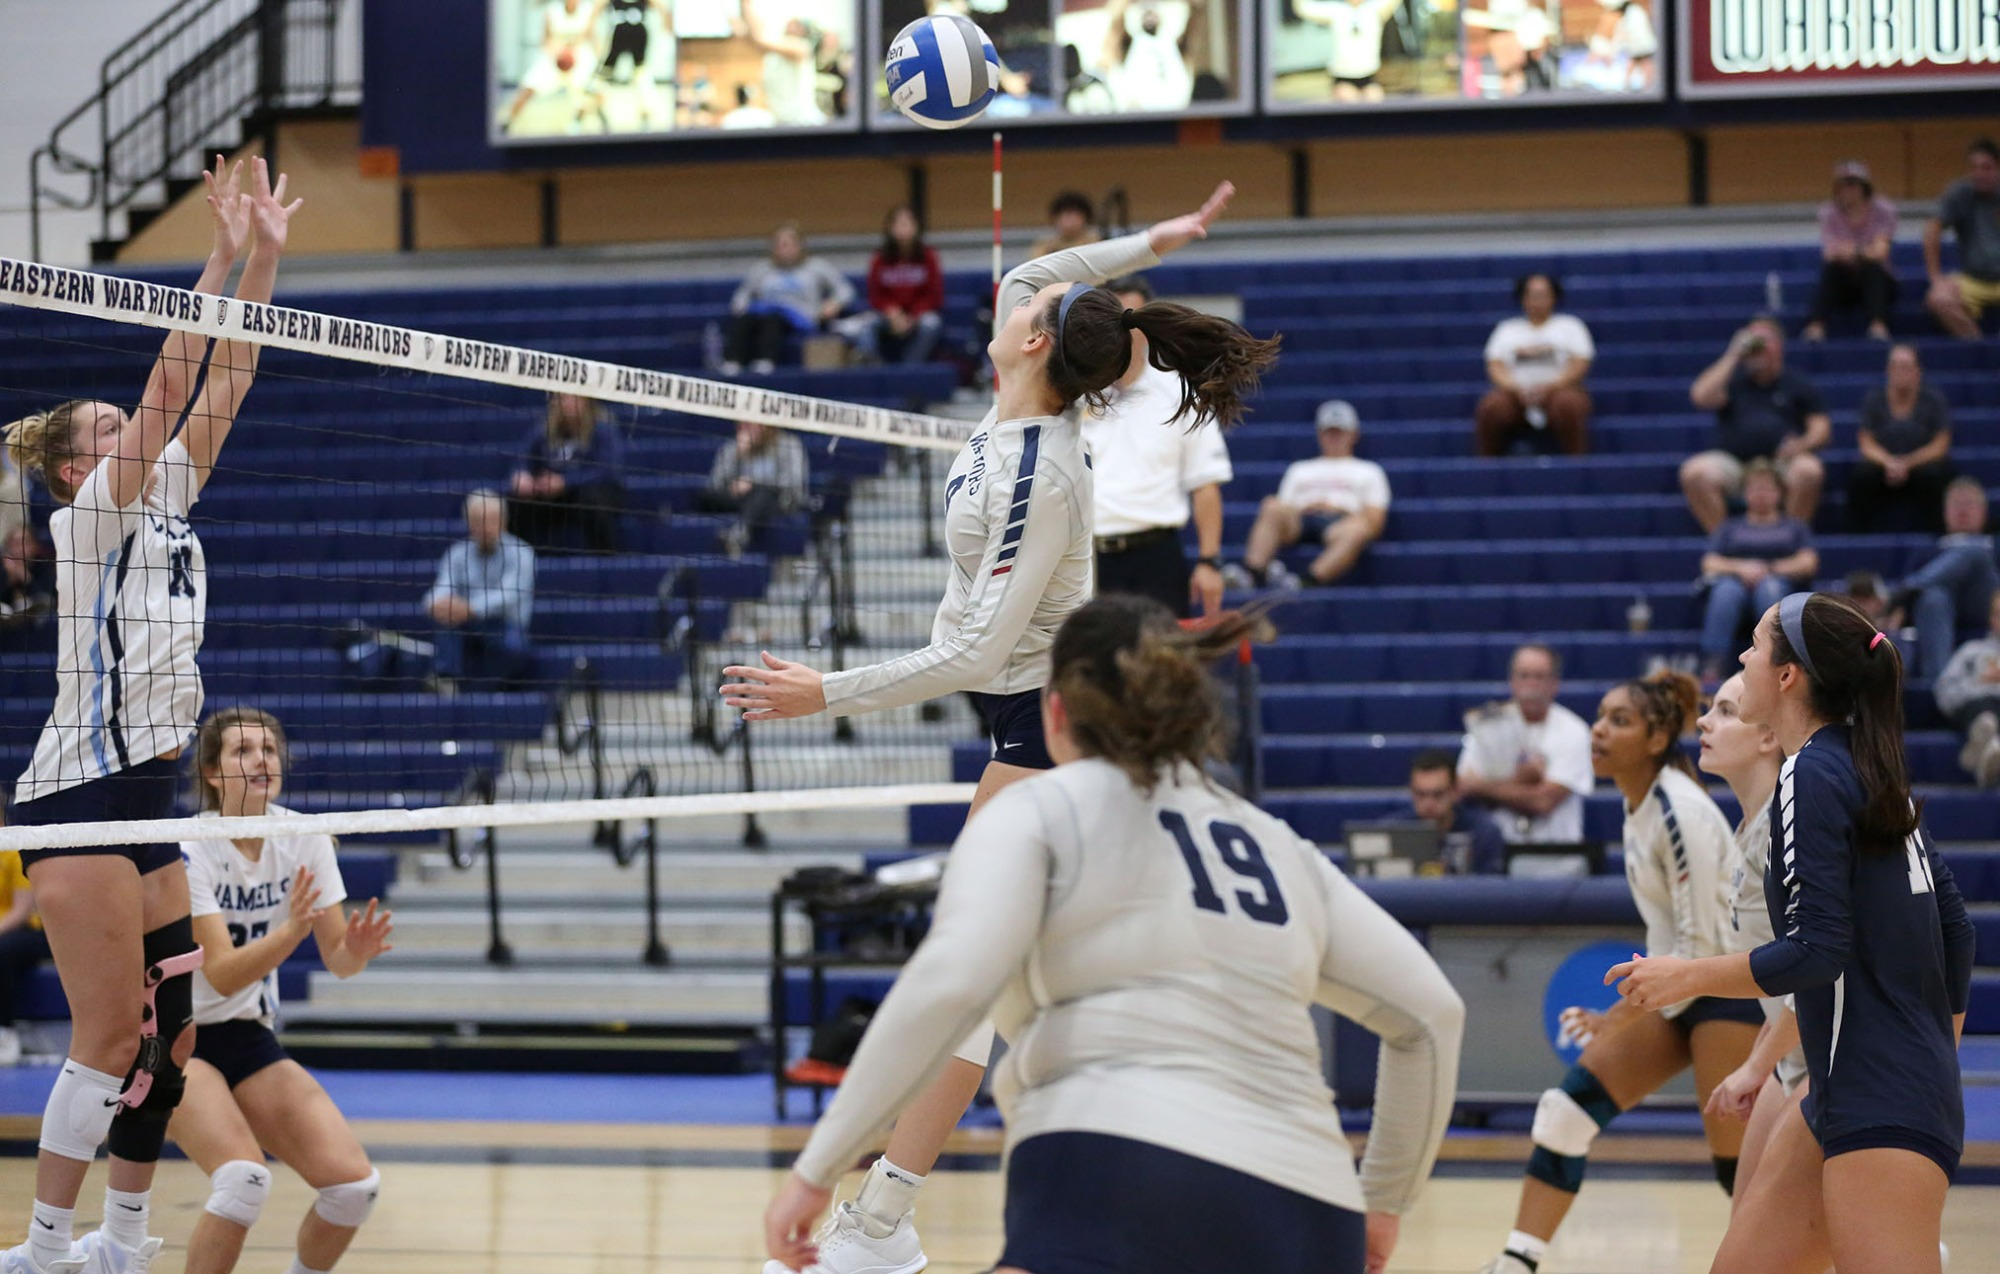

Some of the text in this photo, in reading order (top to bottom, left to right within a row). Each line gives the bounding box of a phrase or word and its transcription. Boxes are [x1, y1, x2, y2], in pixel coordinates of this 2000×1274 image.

[0, 260, 95, 305] EASTERN
[104, 278, 203, 322] WARRIORS
[242, 303, 321, 342] EASTERN
[328, 318, 411, 357] WARRIORS
[445, 339, 511, 373] EASTERN
[517, 351, 588, 385] WARRIORS
[1158, 810, 1288, 926] 19
